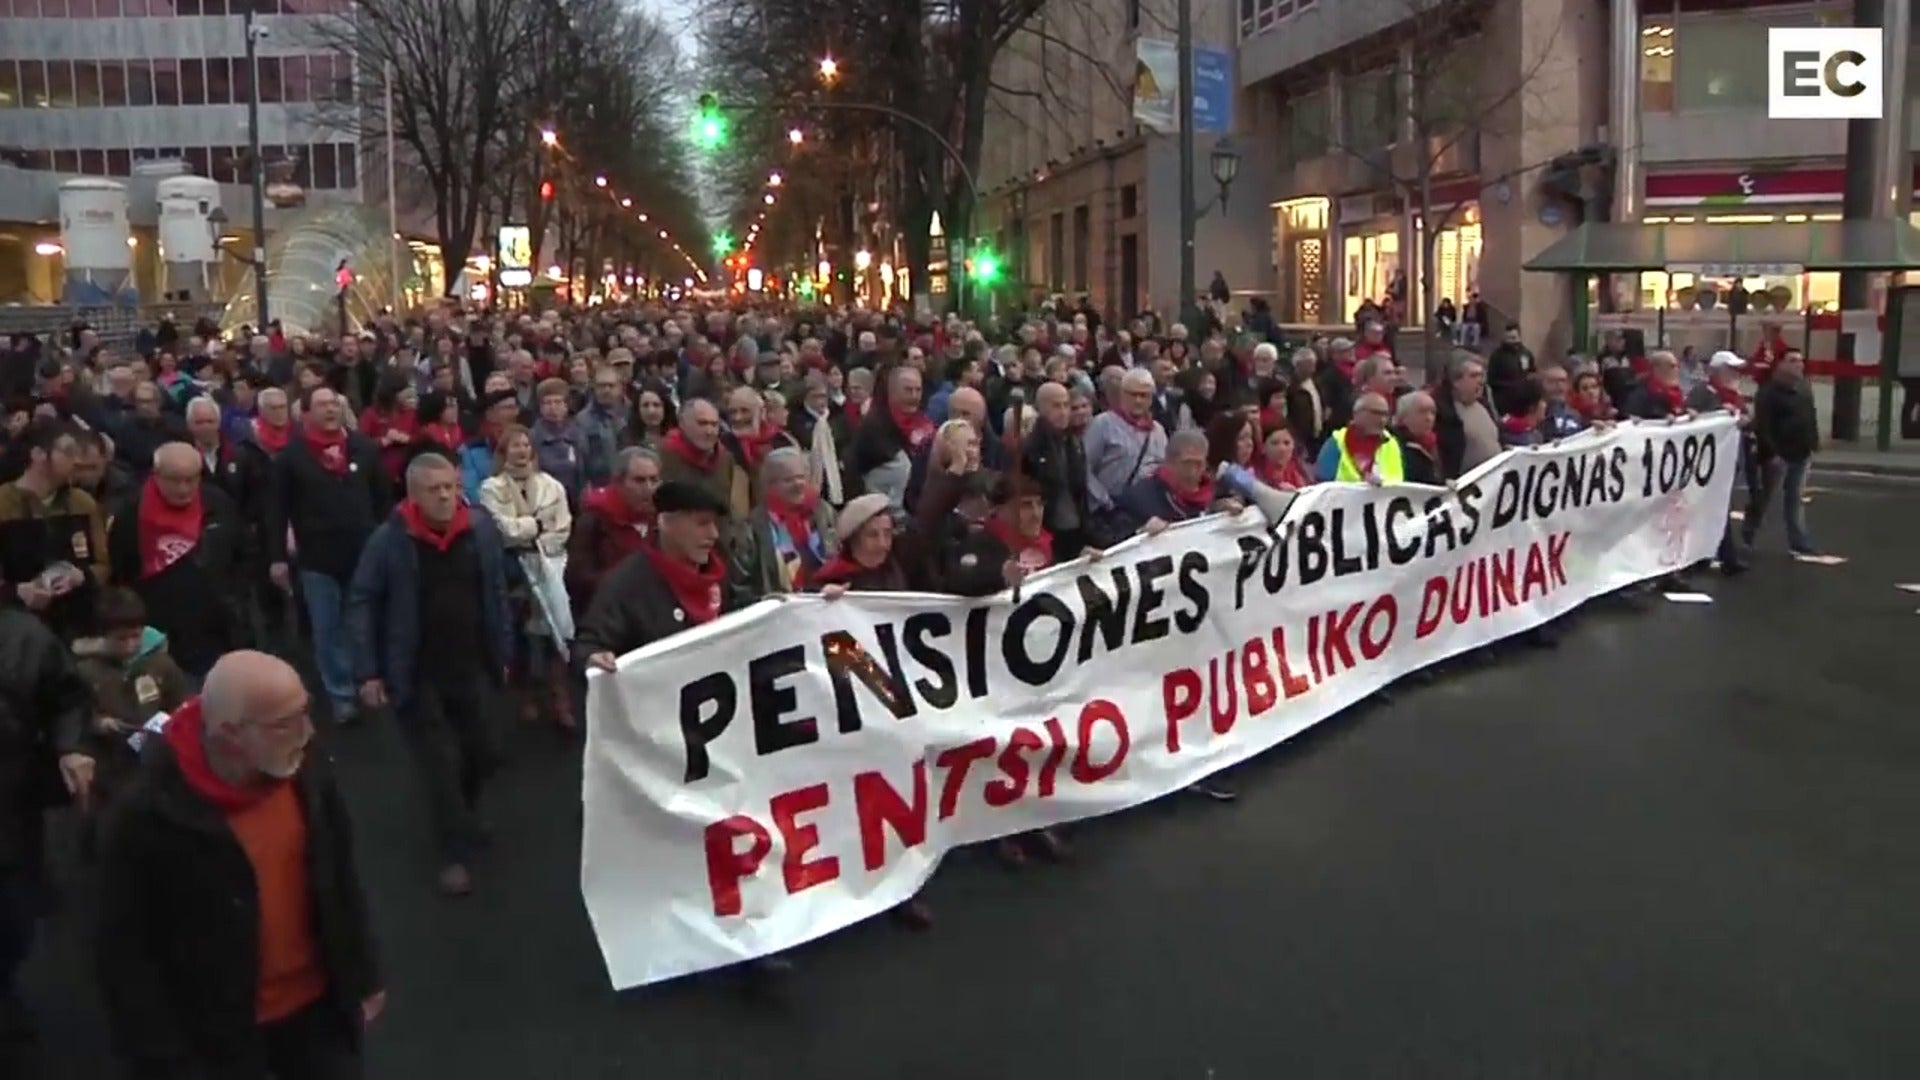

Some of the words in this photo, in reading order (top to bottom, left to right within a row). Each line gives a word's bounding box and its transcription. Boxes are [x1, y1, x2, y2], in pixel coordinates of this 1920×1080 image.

[680, 550, 1210, 784] PENSIONES
[1492, 446, 1627, 530] DIGNAS
[1641, 432, 1716, 497] 1080
[703, 699, 1131, 918] PENTSIO
[1163, 594, 1399, 754] PUBLIKO
[1415, 530, 1571, 640] DUINAK
